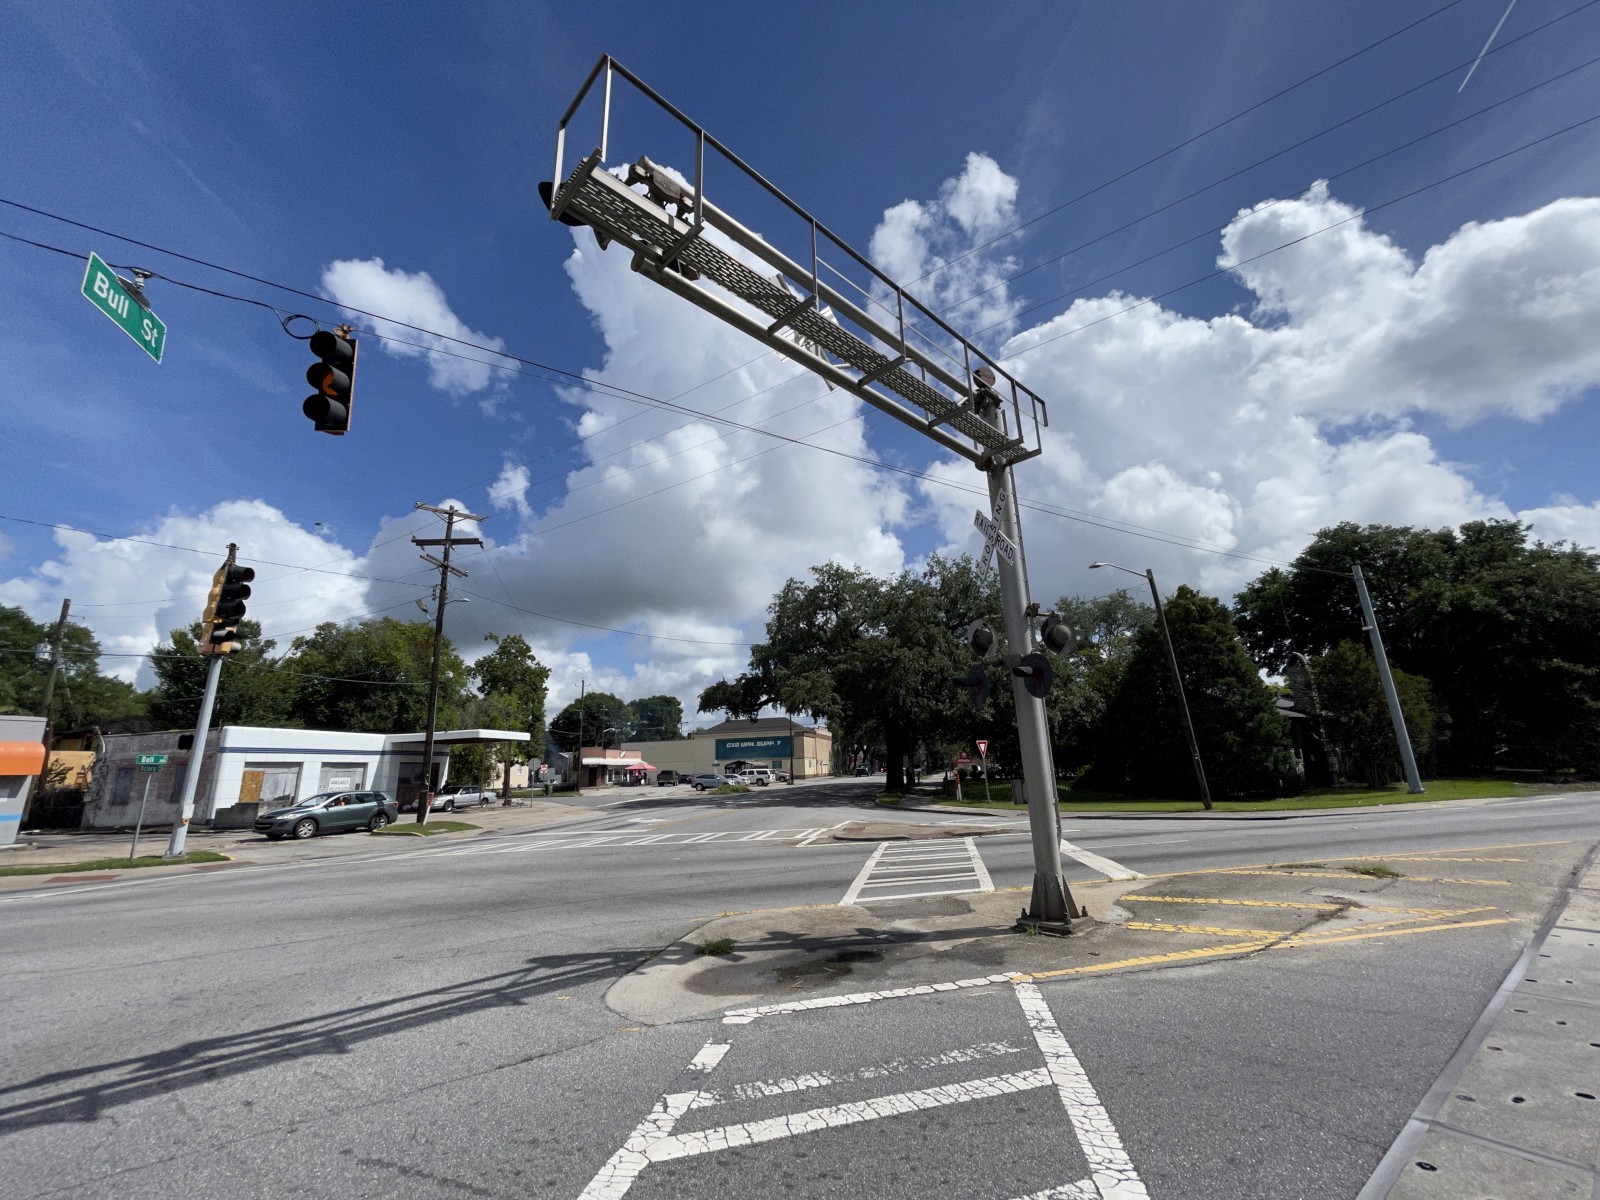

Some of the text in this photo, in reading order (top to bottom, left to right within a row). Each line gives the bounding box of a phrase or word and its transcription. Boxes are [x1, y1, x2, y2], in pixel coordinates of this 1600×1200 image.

[93, 271, 158, 347] Bull St
[979, 492, 1006, 576] CROSSING
